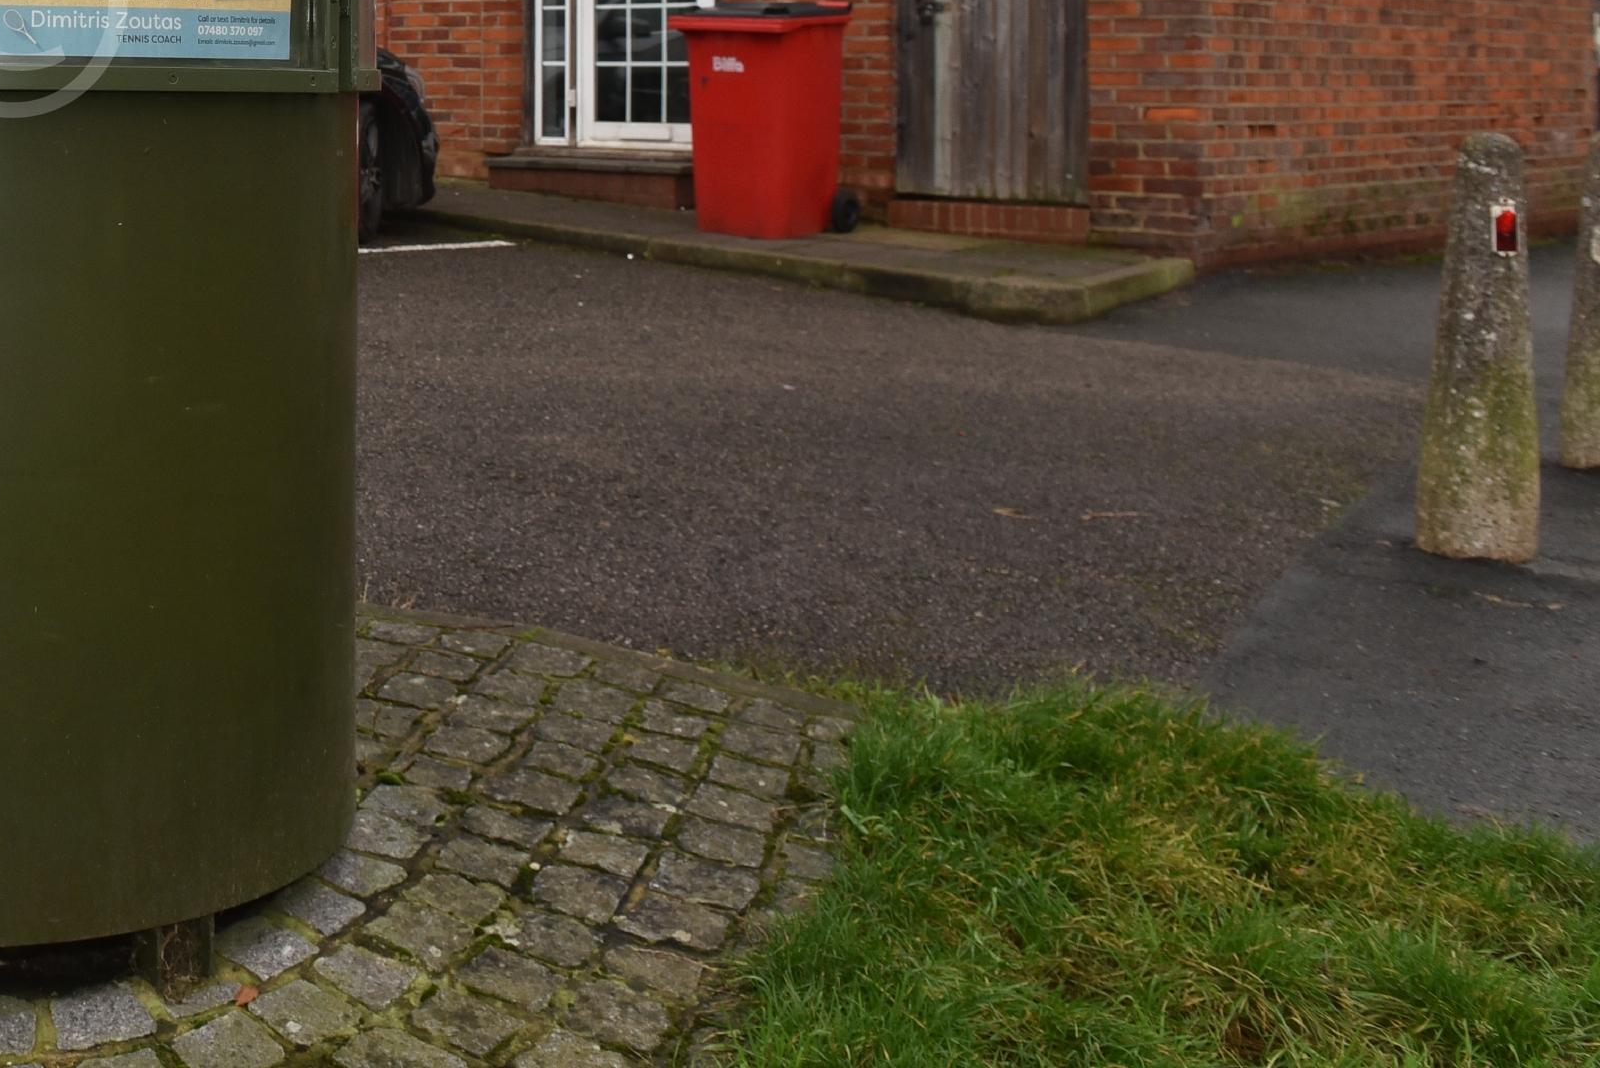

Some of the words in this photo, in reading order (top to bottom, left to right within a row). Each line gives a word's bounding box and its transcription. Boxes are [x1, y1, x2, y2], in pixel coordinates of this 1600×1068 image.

[32, 10, 109, 28] Dimitris
[114, 11, 182, 30] Zoutas
[198, 25, 228, 35] 07480
[230, 26, 246, 36] 370
[248, 26, 263, 36] 097
[118, 34, 150, 43] TENNIS
[152, 35, 182, 44] COACH
